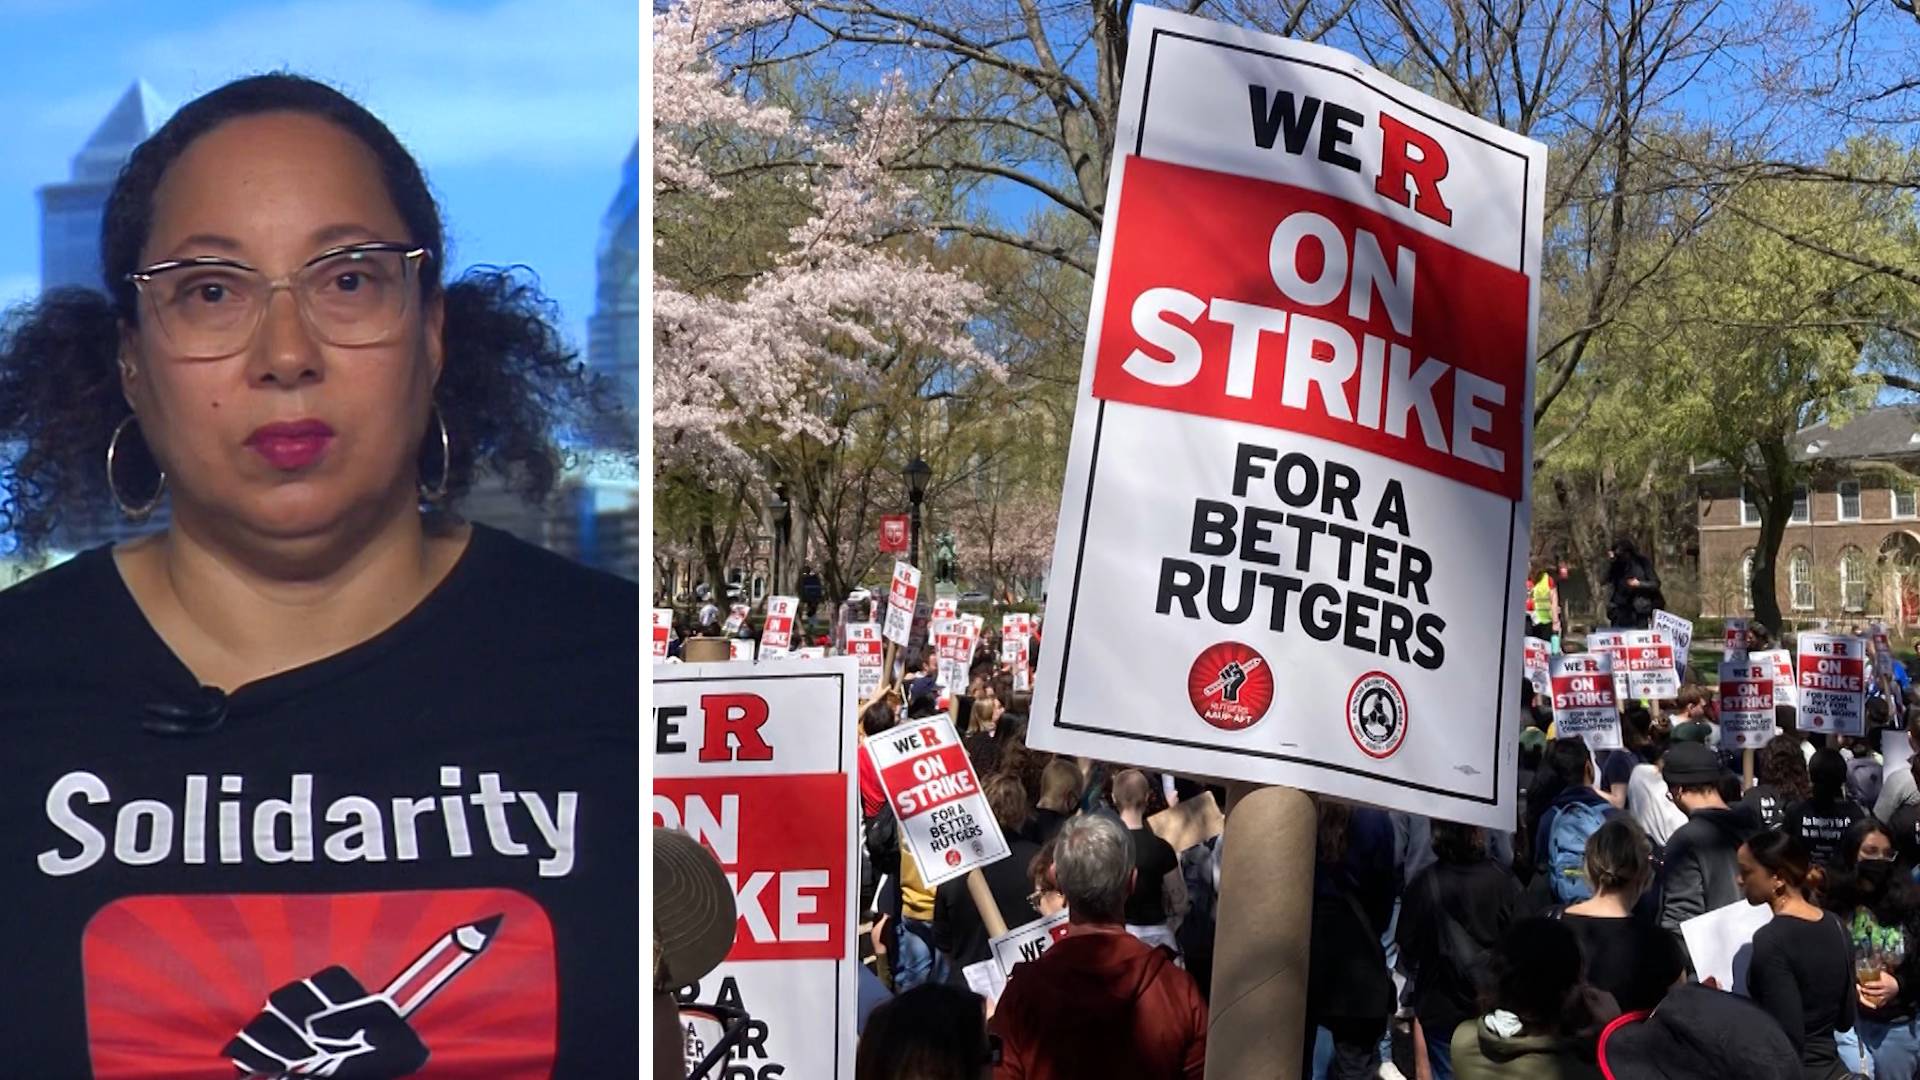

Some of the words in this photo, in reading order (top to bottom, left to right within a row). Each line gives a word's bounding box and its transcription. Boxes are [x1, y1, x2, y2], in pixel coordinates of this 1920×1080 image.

[1248, 84, 1365, 173] WE
[1375, 111, 1453, 227] R
[1269, 211, 1417, 338] ON
[1121, 286, 1506, 473] STRIKE
[1232, 442, 1361, 521] FOR
[1372, 478, 1410, 537] A
[1190, 498, 1433, 605] BETTER
[1155, 557, 1447, 671] RUTGERS
[863, 628, 874, 639] R
[1651, 634, 1662, 644] R
[1641, 648, 1659, 659] ON
[1814, 642, 1831, 654] WE
[1832, 642, 1848, 656] R
[1563, 662, 1581, 672] WE
[1583, 660, 1600, 672] R
[1630, 658, 1672, 670] STRIKE
[1733, 668, 1748, 678] WE
[1751, 667, 1763, 678] R
[1817, 659, 1841, 674] ON
[1571, 678, 1594, 691] ON
[1737, 683, 1759, 695] ON
[1801, 670, 1860, 691] STRIKE
[1555, 692, 1613, 709] STRIKE
[1723, 694, 1773, 709] STRIKE
[1824, 692, 1855, 703] EQUAL
[1802, 706, 1829, 716] EQUAL
[653, 706, 687, 753] E
[698, 693, 774, 762] R
[894, 735, 922, 755] WE
[919, 726, 942, 749] R
[912, 753, 947, 782] ON
[896, 769, 975, 813] STRIKE
[36, 766, 579, 877] Solidarity
[930, 806, 957, 824] FOR
[957, 803, 966, 815] A
[653, 793, 740, 865] N
[930, 814, 975, 839] BETTER
[930, 825, 984, 853] RUTGERS
